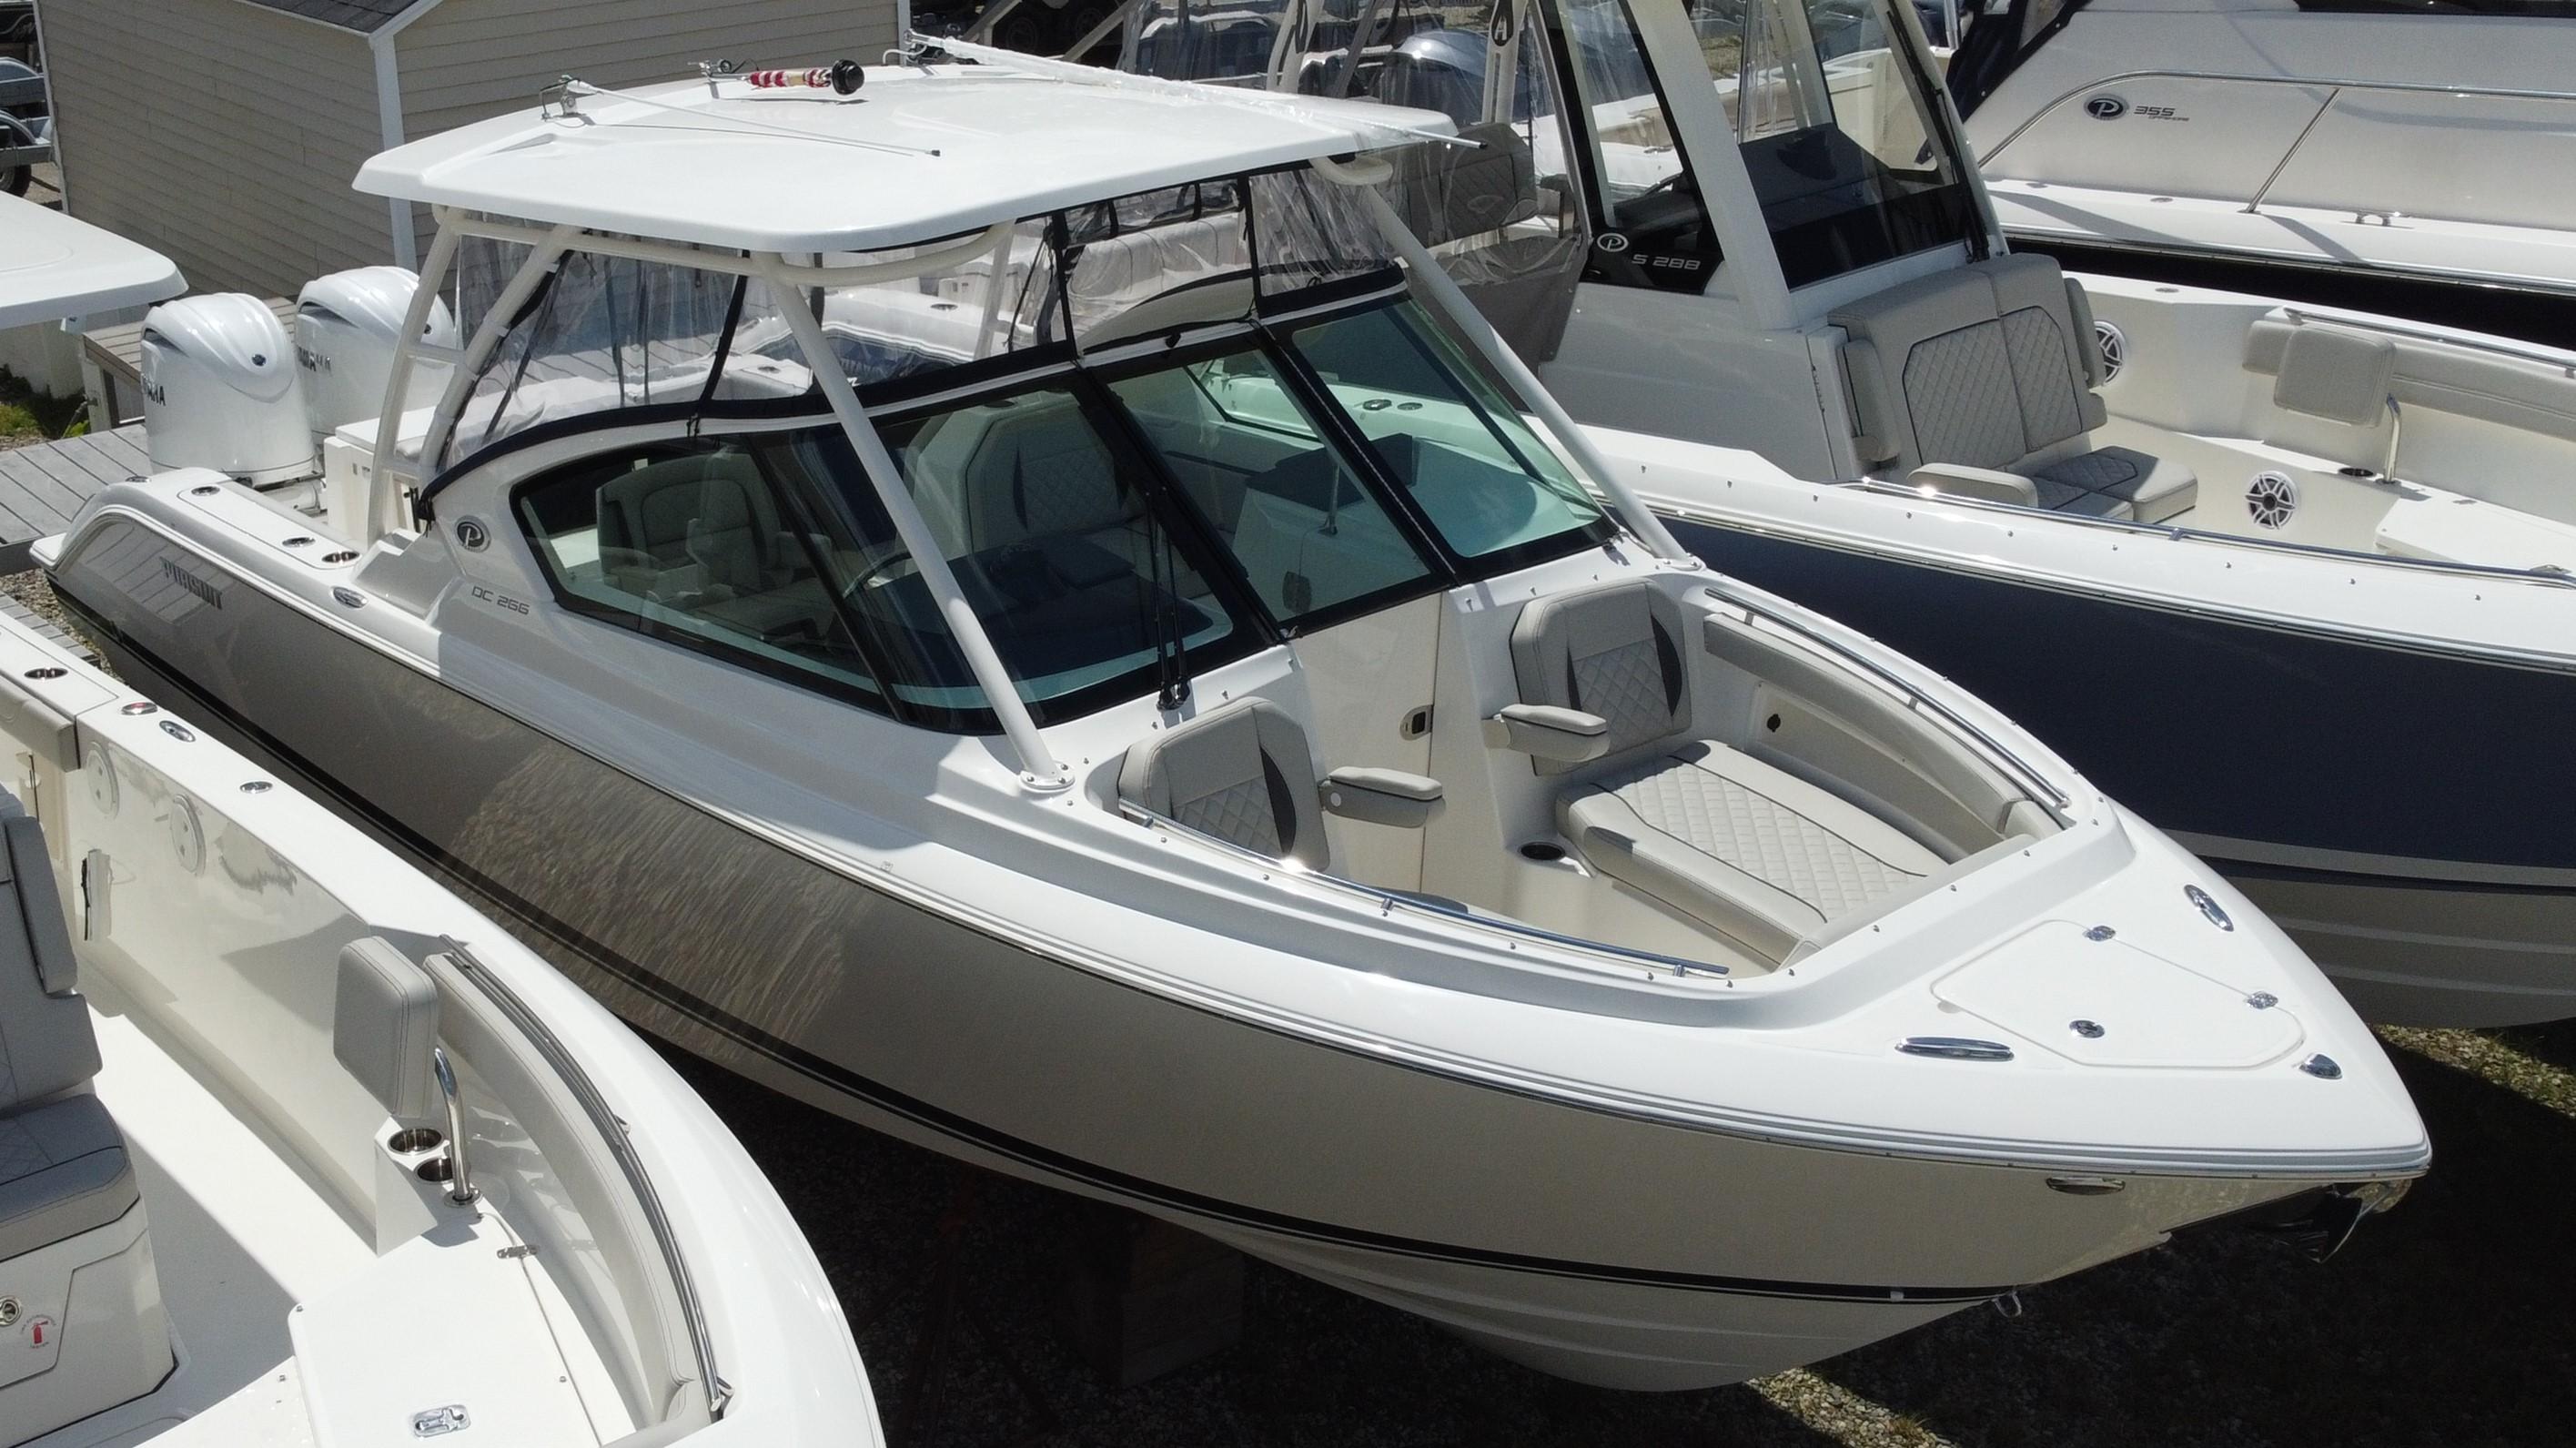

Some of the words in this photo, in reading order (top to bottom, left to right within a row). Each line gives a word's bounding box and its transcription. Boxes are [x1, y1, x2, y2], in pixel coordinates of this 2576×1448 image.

[2134, 105, 2176, 116] 355
[1631, 254, 1649, 265] S
[1652, 256, 1702, 270] 288
[159, 556, 223, 610] PURSUIT
[471, 585, 494, 602] DC
[497, 594, 530, 615] 266
